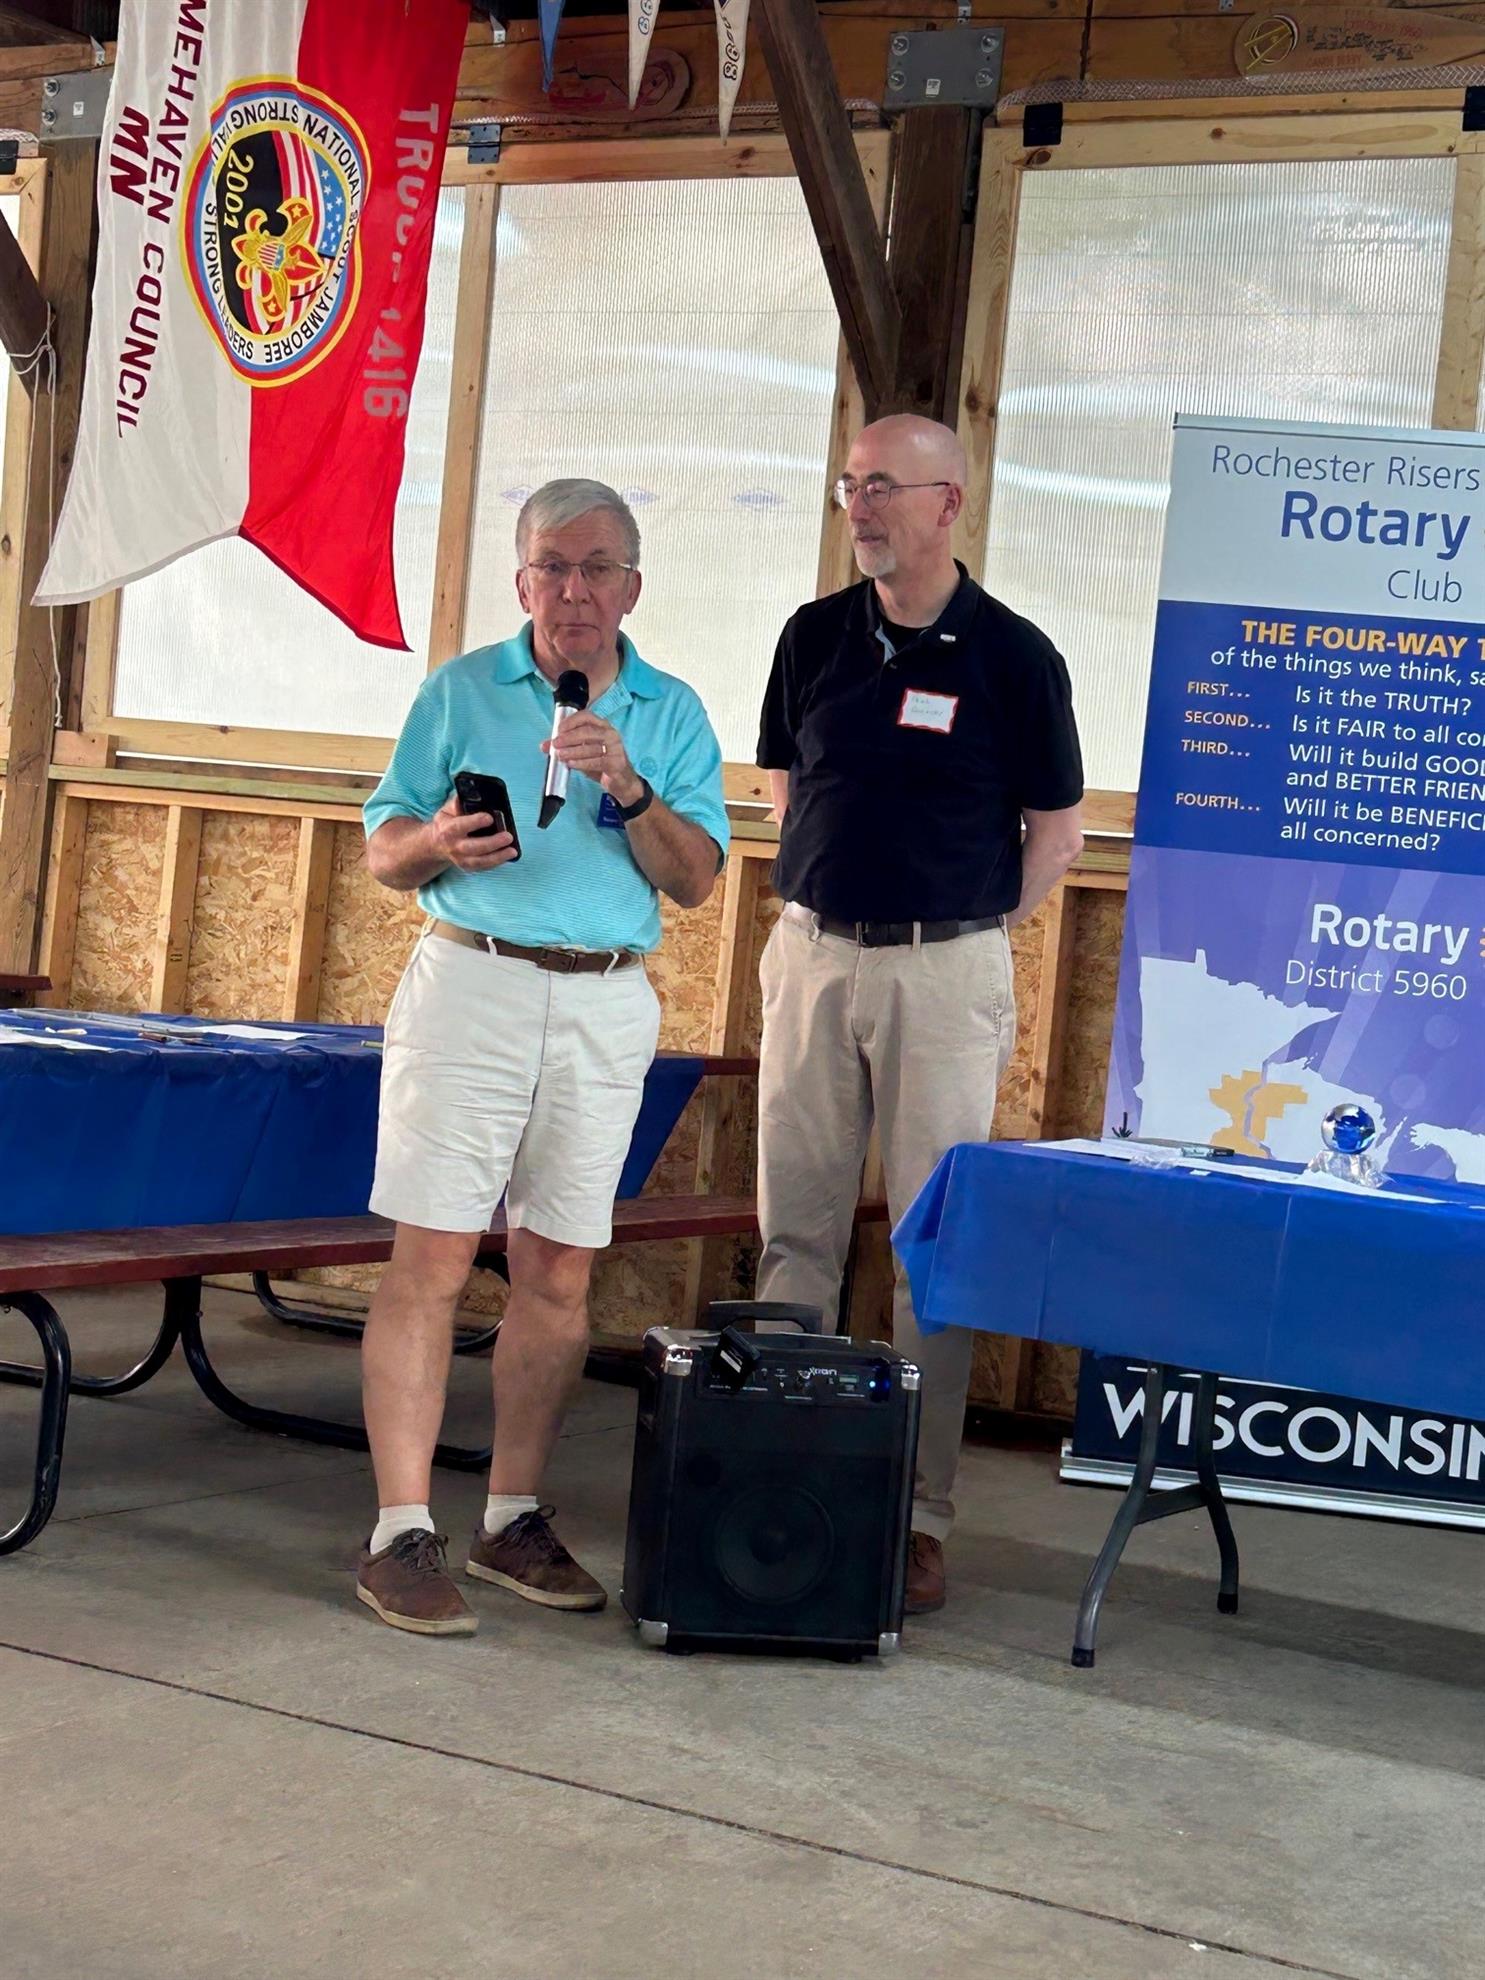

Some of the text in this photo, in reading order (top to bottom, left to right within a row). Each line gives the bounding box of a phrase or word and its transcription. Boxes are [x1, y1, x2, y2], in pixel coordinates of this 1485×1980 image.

[231, 101, 298, 130] STRONG
[110, 106, 151, 205] MN
[303, 114, 361, 205] NATIONAL
[224, 148, 255, 229] 2001
[204, 203, 223, 294] STRONG
[116, 242, 164, 438] COUNCIL
[264, 286, 334, 363] JAMBOREE
[1212, 445, 1480, 491] Rochester Risers
[1281, 490, 1471, 561] Rotary
[1388, 569, 1462, 603] Club
[1241, 620, 1297, 646] THE
[1305, 625, 1469, 659] FOUR-WAY
[1211, 646, 1236, 666] of
[1240, 648, 1277, 669] the
[1284, 652, 1352, 680] things
[1359, 662, 1391, 679] we
[1399, 661, 1461, 687] think,
[1187, 681, 1250, 698] FIRST...
[1295, 685, 1472, 716] Is it the TRUTH?
[1184, 710, 1271, 729] SECOND...
[1292, 714, 1485, 747] Is it FAIR to all co
[1181, 739, 1250, 758] THIRD...
[1289, 743, 1332, 765] Will
[1340, 747, 1355, 766] it
[1361, 748, 1418, 771] build
[1286, 770, 1328, 789] and
[1335, 772, 1416, 795] BETTER
[1175, 792, 1260, 811] FOURTH...
[1284, 796, 1327, 817] Will
[1334, 800, 1349, 819] it
[1356, 802, 1383, 822] be
[1280, 821, 1441, 851] all concerned?
[1311, 903, 1470, 965] Rotary
[1284, 959, 1467, 1000] District 5960
